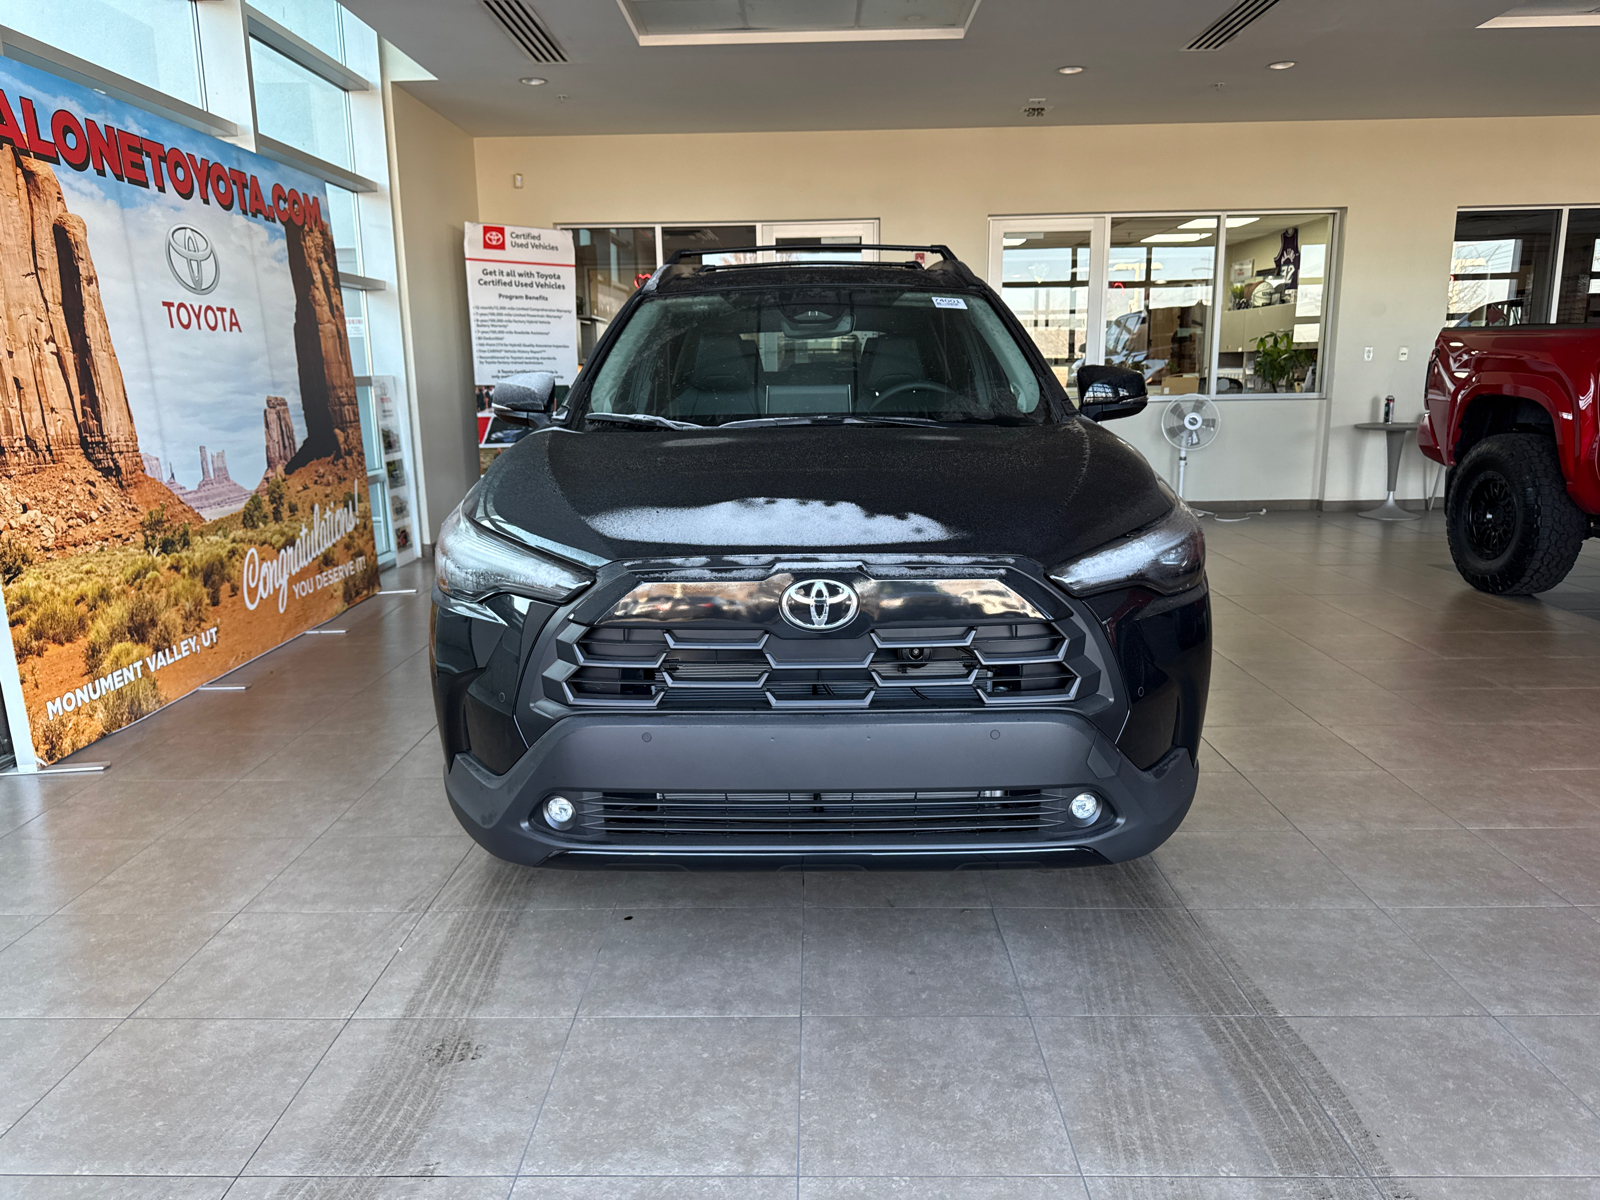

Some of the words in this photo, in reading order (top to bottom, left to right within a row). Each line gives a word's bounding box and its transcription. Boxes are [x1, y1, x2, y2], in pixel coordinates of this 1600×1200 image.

[510, 231, 541, 241] Certified
[510, 240, 529, 249] Used
[530, 242, 559, 251] Vehicles
[482, 268, 497, 276] Get
[498, 269, 504, 277] it
[517, 270, 535, 278] with
[536, 271, 561, 281] Toyota
[478, 278, 513, 287] Certified
[514, 280, 533, 288] Used
[534, 282, 566, 290] Vehicles
[498, 293, 524, 301] Program
[162, 301, 243, 333] TOYOTA
[243, 478, 361, 613] Congratulations!
[292, 579, 314, 599] YOU
[315, 562, 355, 593] DESERVE
[355, 556, 366, 577] IT!
[46, 659, 144, 720] MONUMENT
[145, 635, 201, 674] VALLEY,
[200, 627, 219, 648] UT
